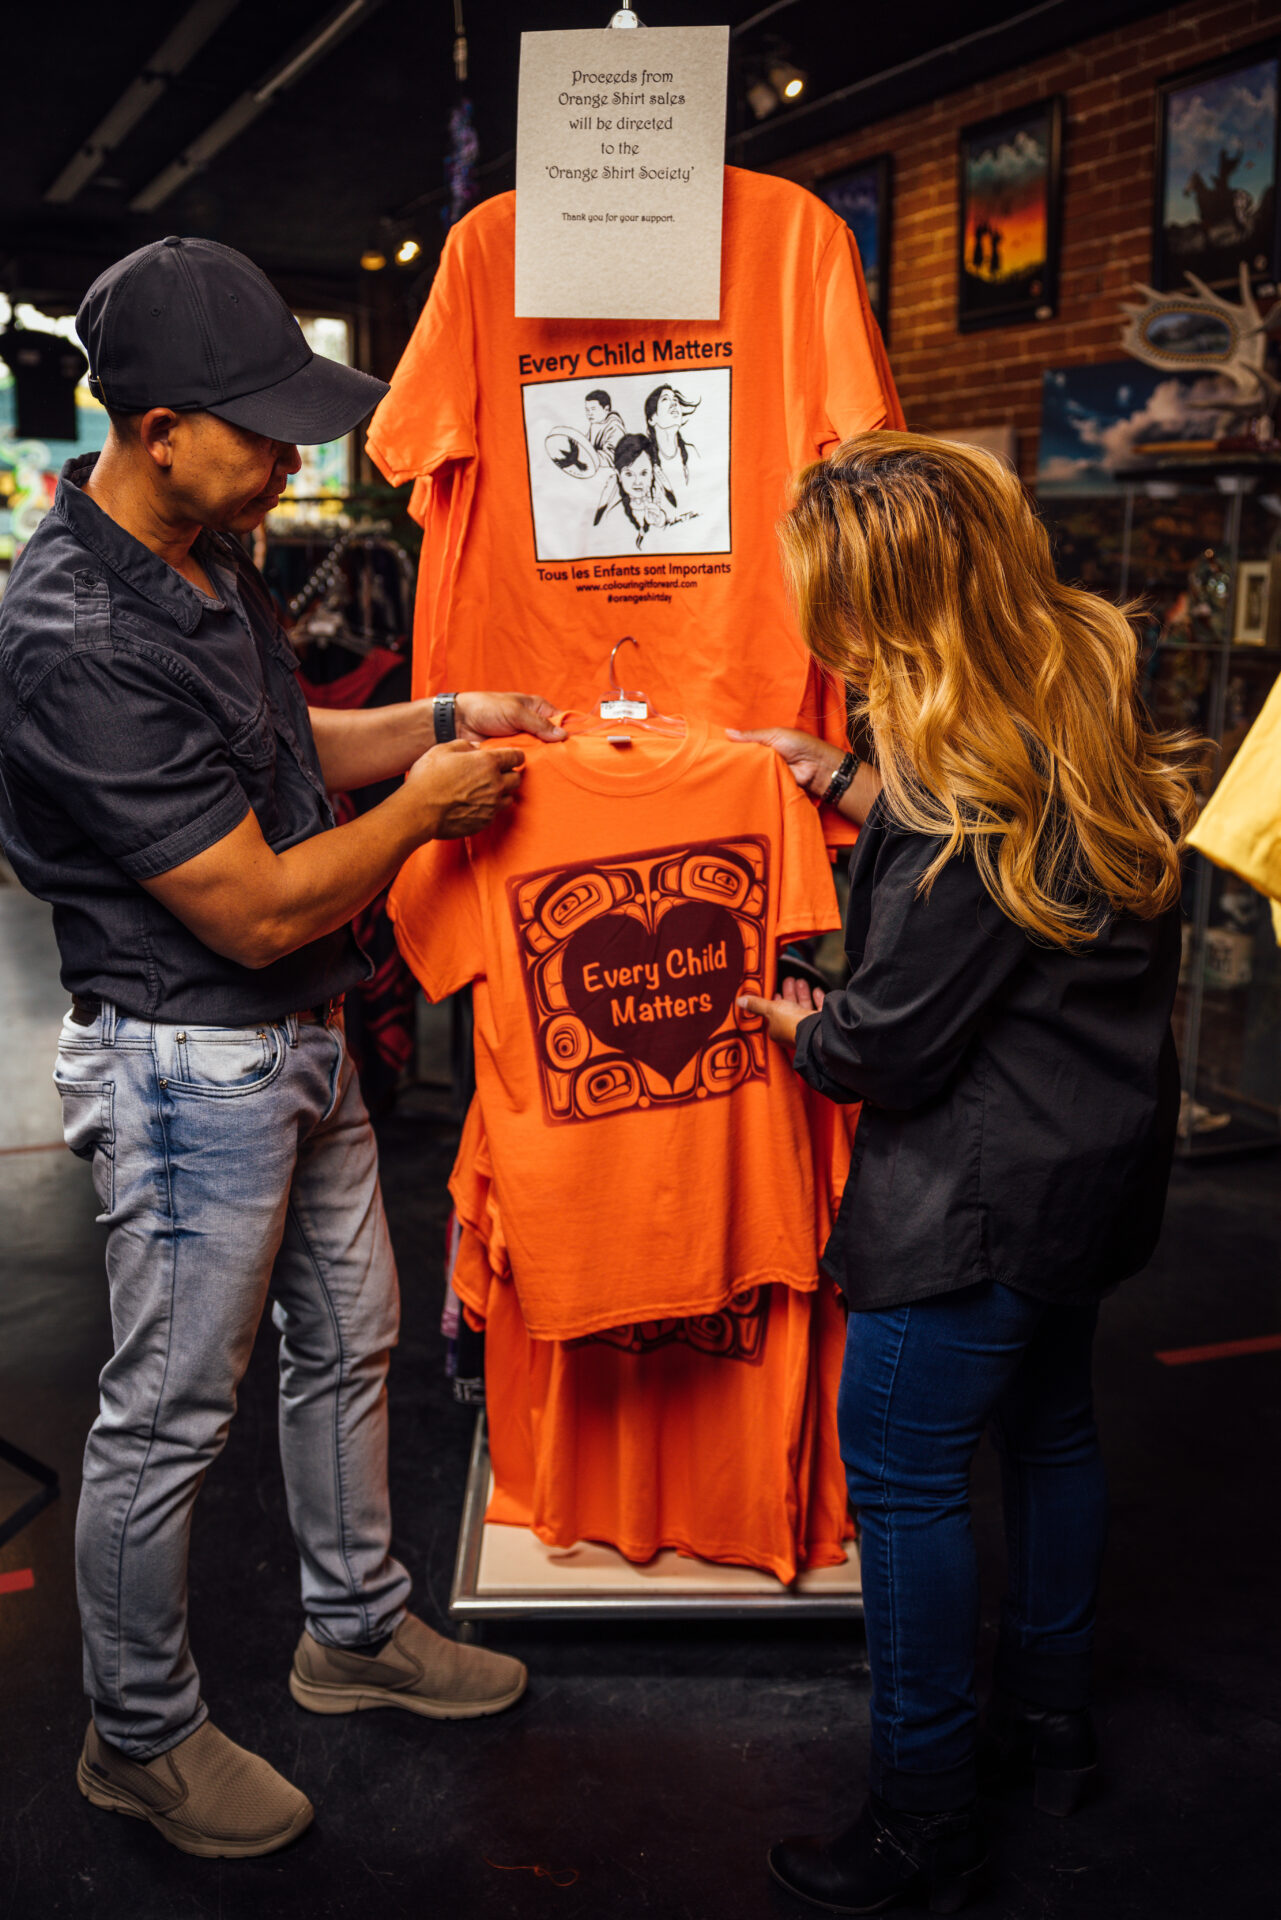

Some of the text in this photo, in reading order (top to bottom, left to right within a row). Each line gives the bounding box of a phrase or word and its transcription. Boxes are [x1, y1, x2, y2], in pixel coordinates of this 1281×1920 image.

[572, 69, 673, 86] Proceeds from
[558, 91, 686, 109] Orange Shirt sales
[569, 117, 673, 131] will be directed
[601, 142, 640, 155] to the
[602, 165, 635, 179] Shirt
[562, 212, 675, 223] Thank you for your support.
[519, 340, 733, 375] Every Child Matters
[536, 562, 731, 581] Tous les Enfants sont Importants
[583, 940, 727, 992] Every Child
[611, 993, 713, 1027] Matters
